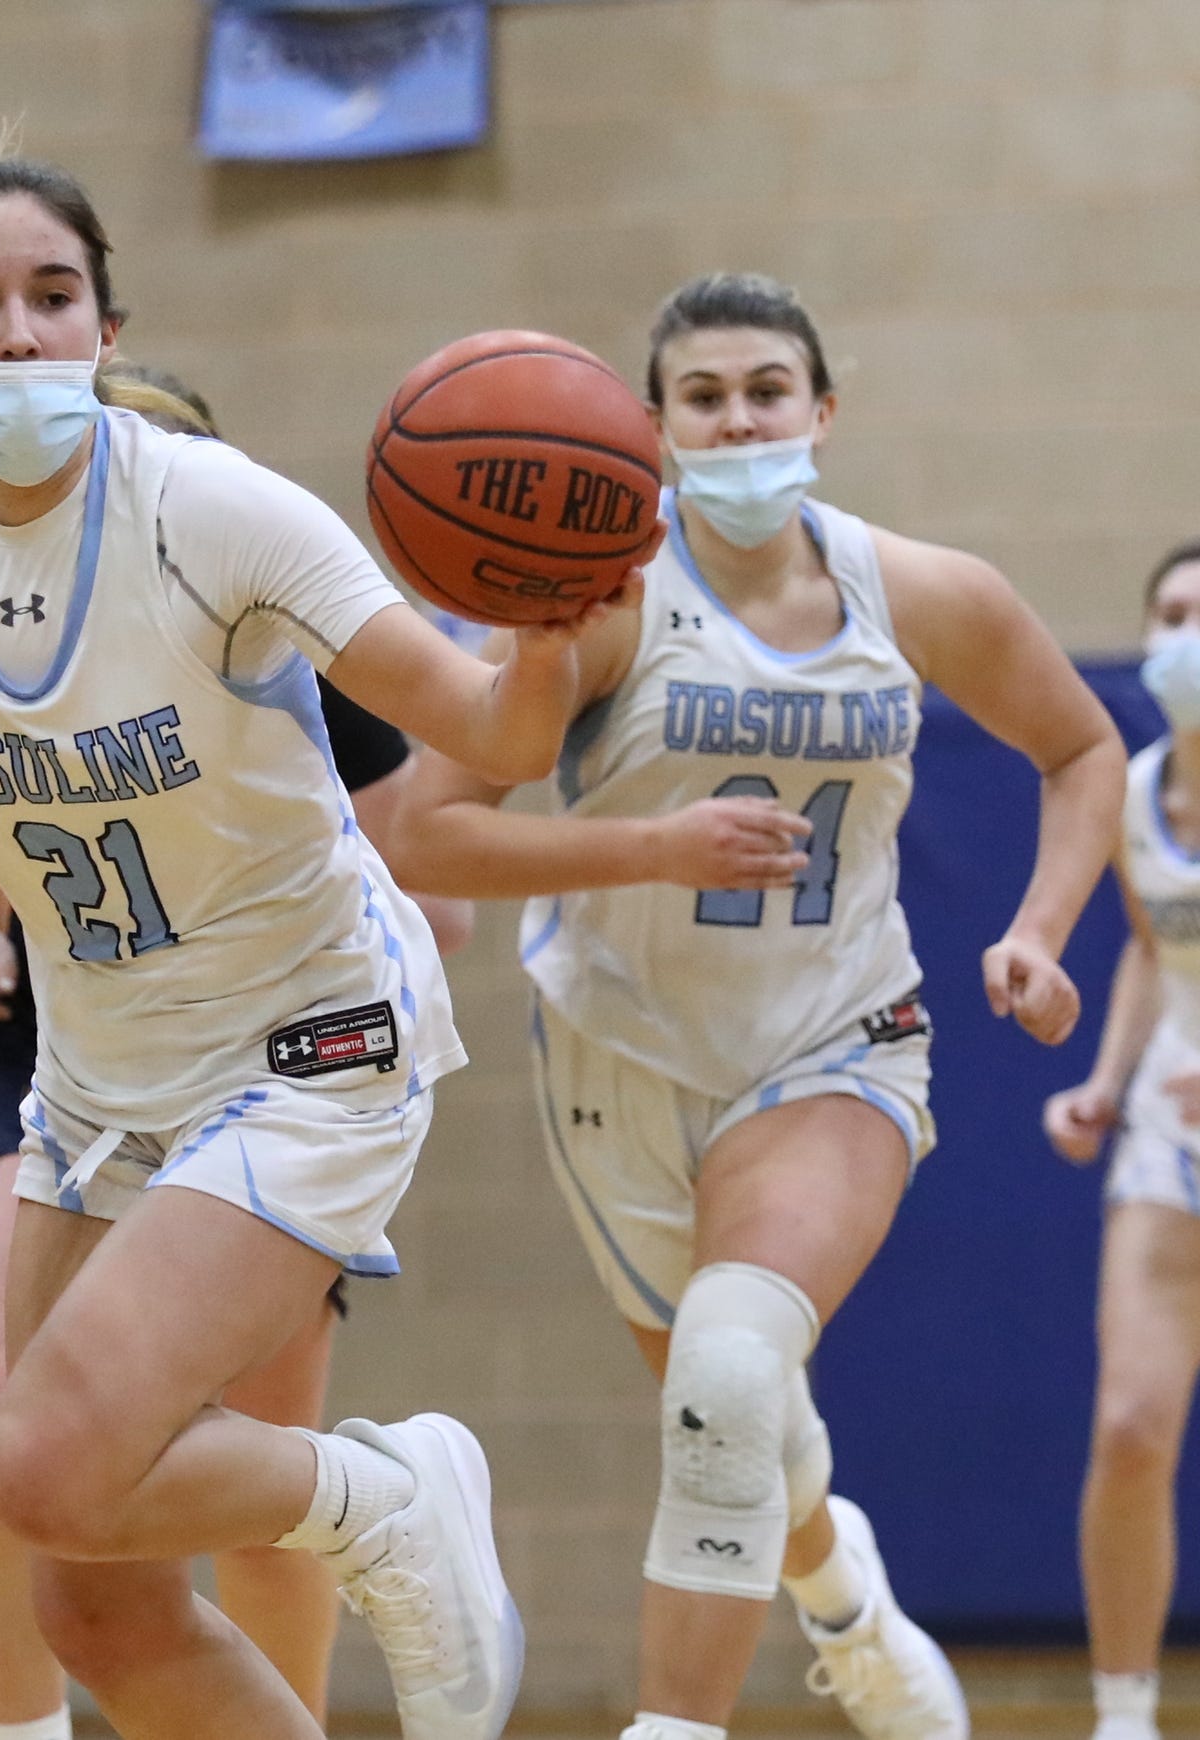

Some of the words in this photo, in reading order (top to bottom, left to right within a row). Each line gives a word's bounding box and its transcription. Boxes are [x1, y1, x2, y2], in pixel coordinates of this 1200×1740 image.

[456, 458, 547, 522] THE
[557, 467, 646, 535] ROCK
[664, 681, 907, 761] URSULINE
[12, 818, 179, 961] 21
[317, 1024, 347, 1035] UNDER
[349, 1016, 386, 1028] ARMOUR
[321, 1039, 364, 1055] AUTHENTIC
[371, 1036, 385, 1045] LG
